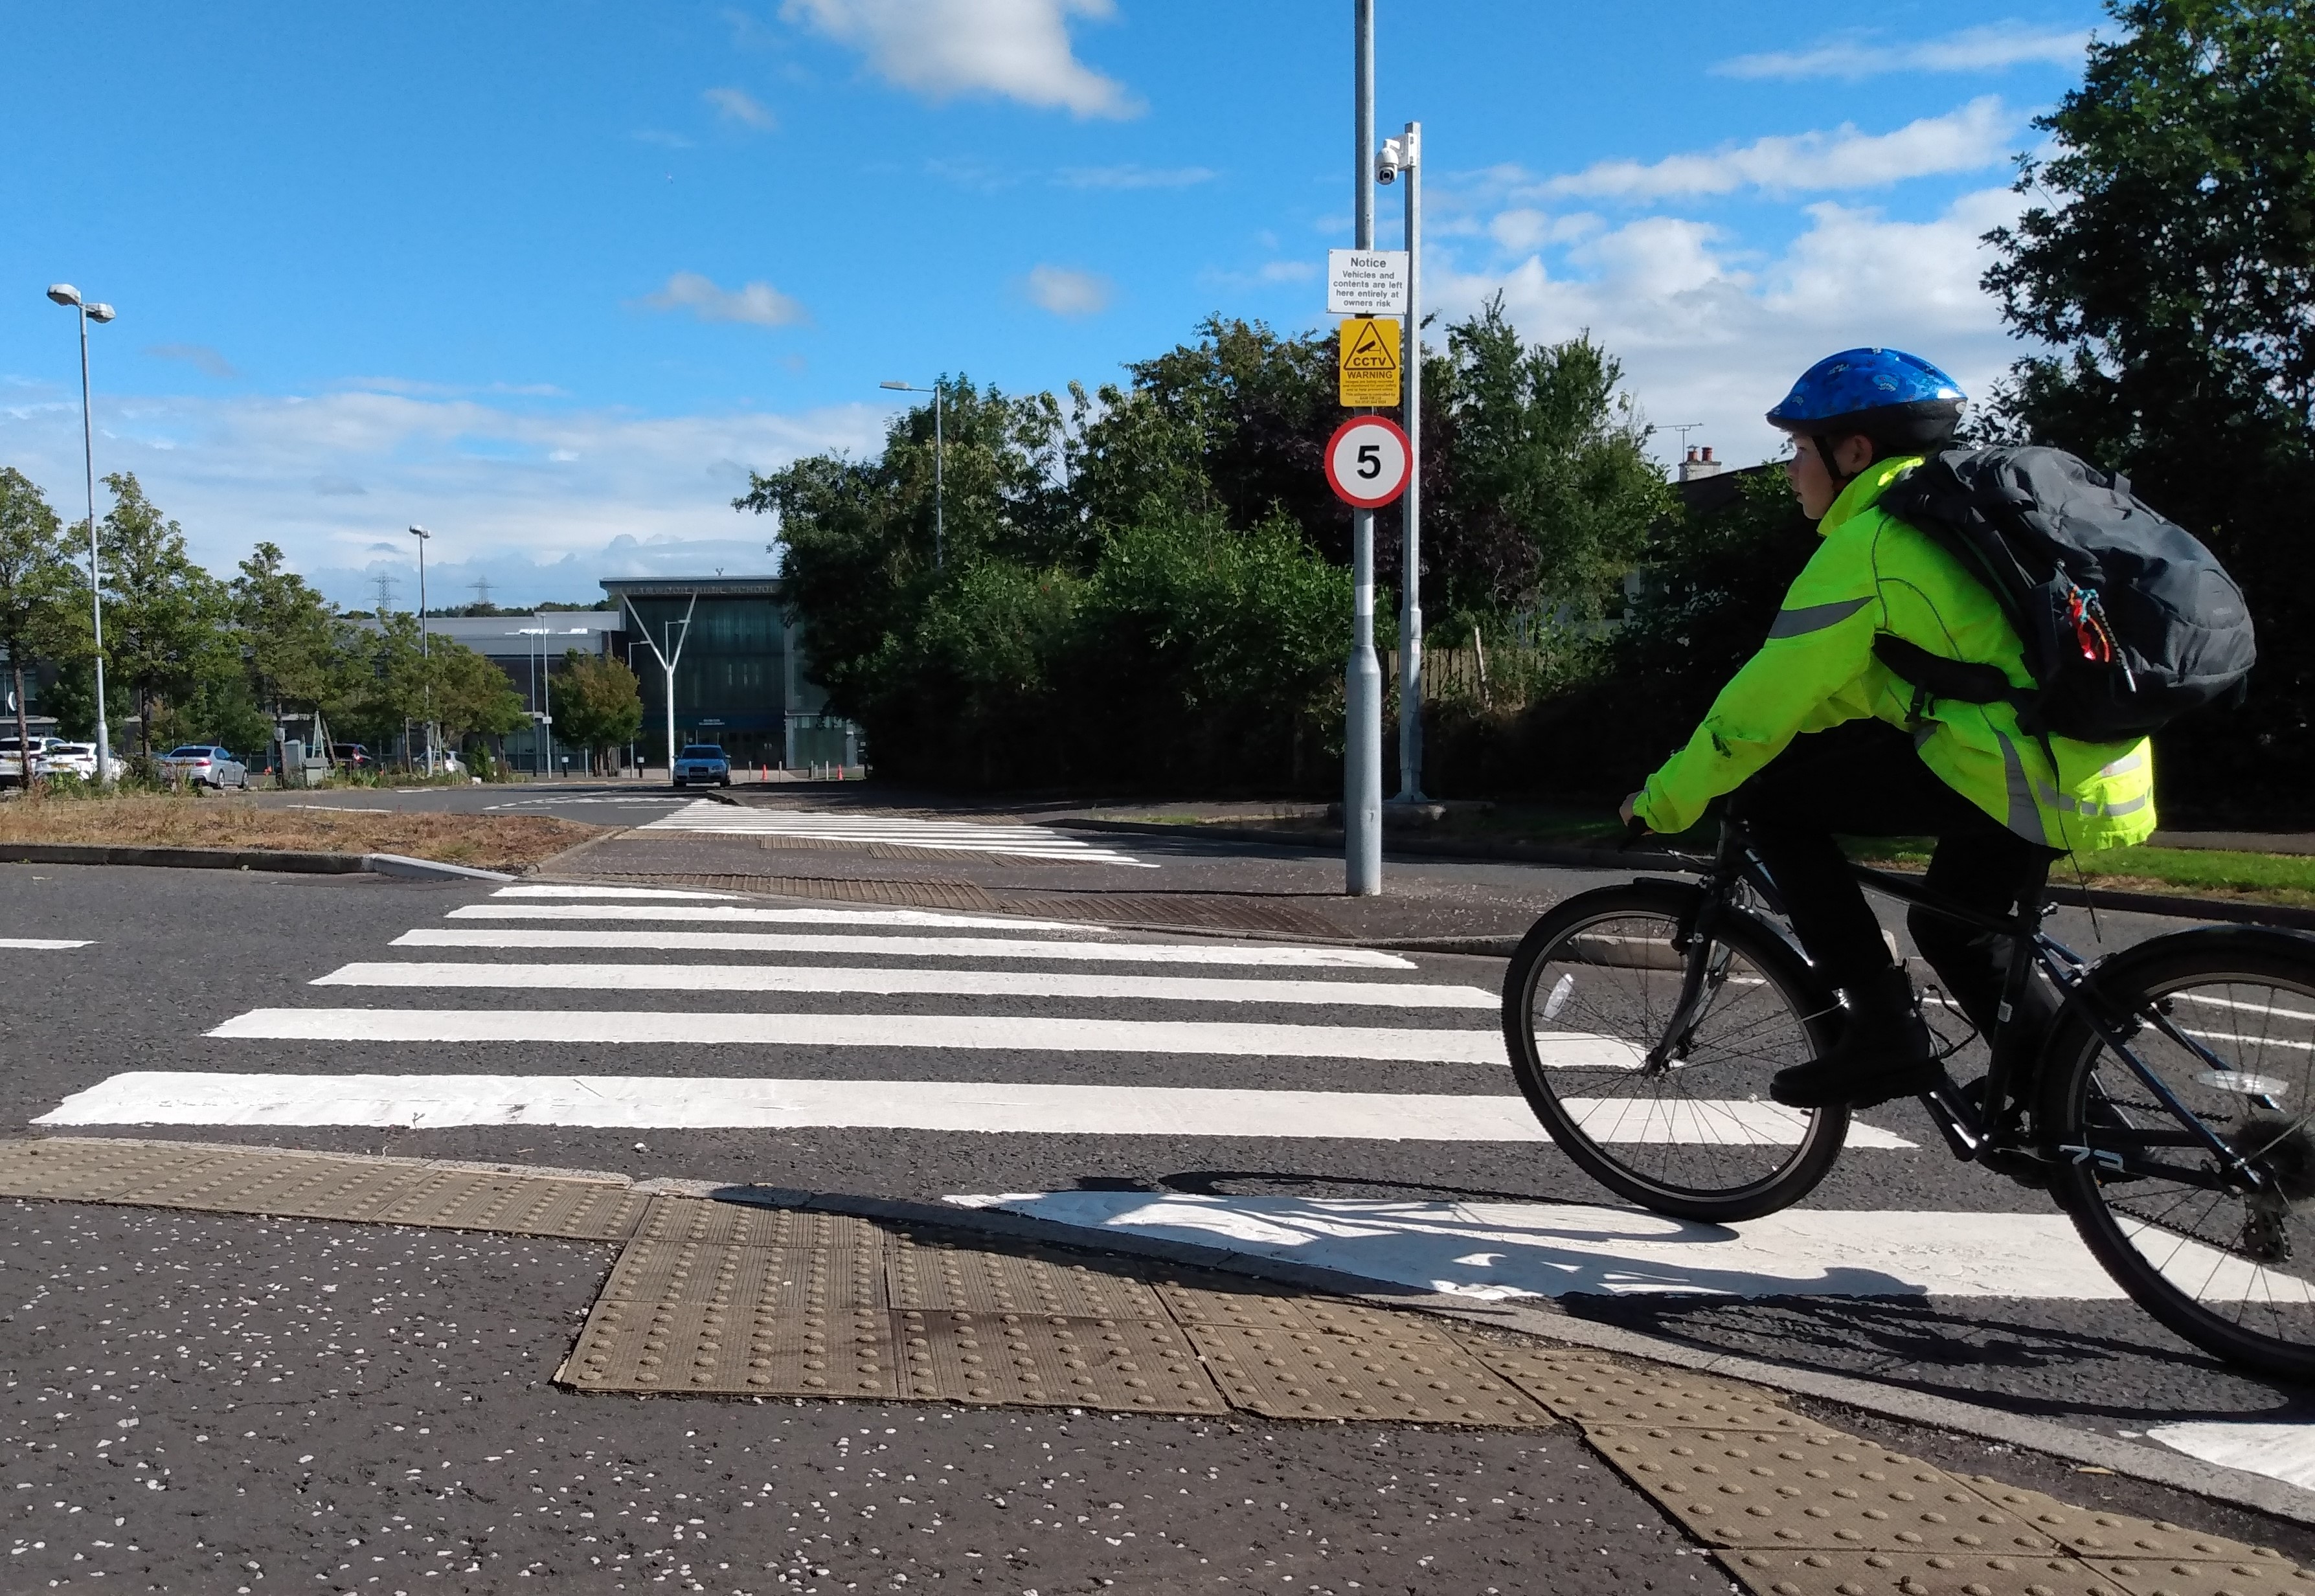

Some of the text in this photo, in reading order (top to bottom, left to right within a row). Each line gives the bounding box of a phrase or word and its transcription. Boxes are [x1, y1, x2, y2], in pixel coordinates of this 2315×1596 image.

[1350, 257, 1386, 268] Notice
[1342, 270, 1376, 278] Vehicles
[1336, 289, 1354, 297] here
[1357, 289, 1388, 299] entirely
[1353, 357, 1386, 366] CCTV
[1357, 445, 1381, 480] 5
